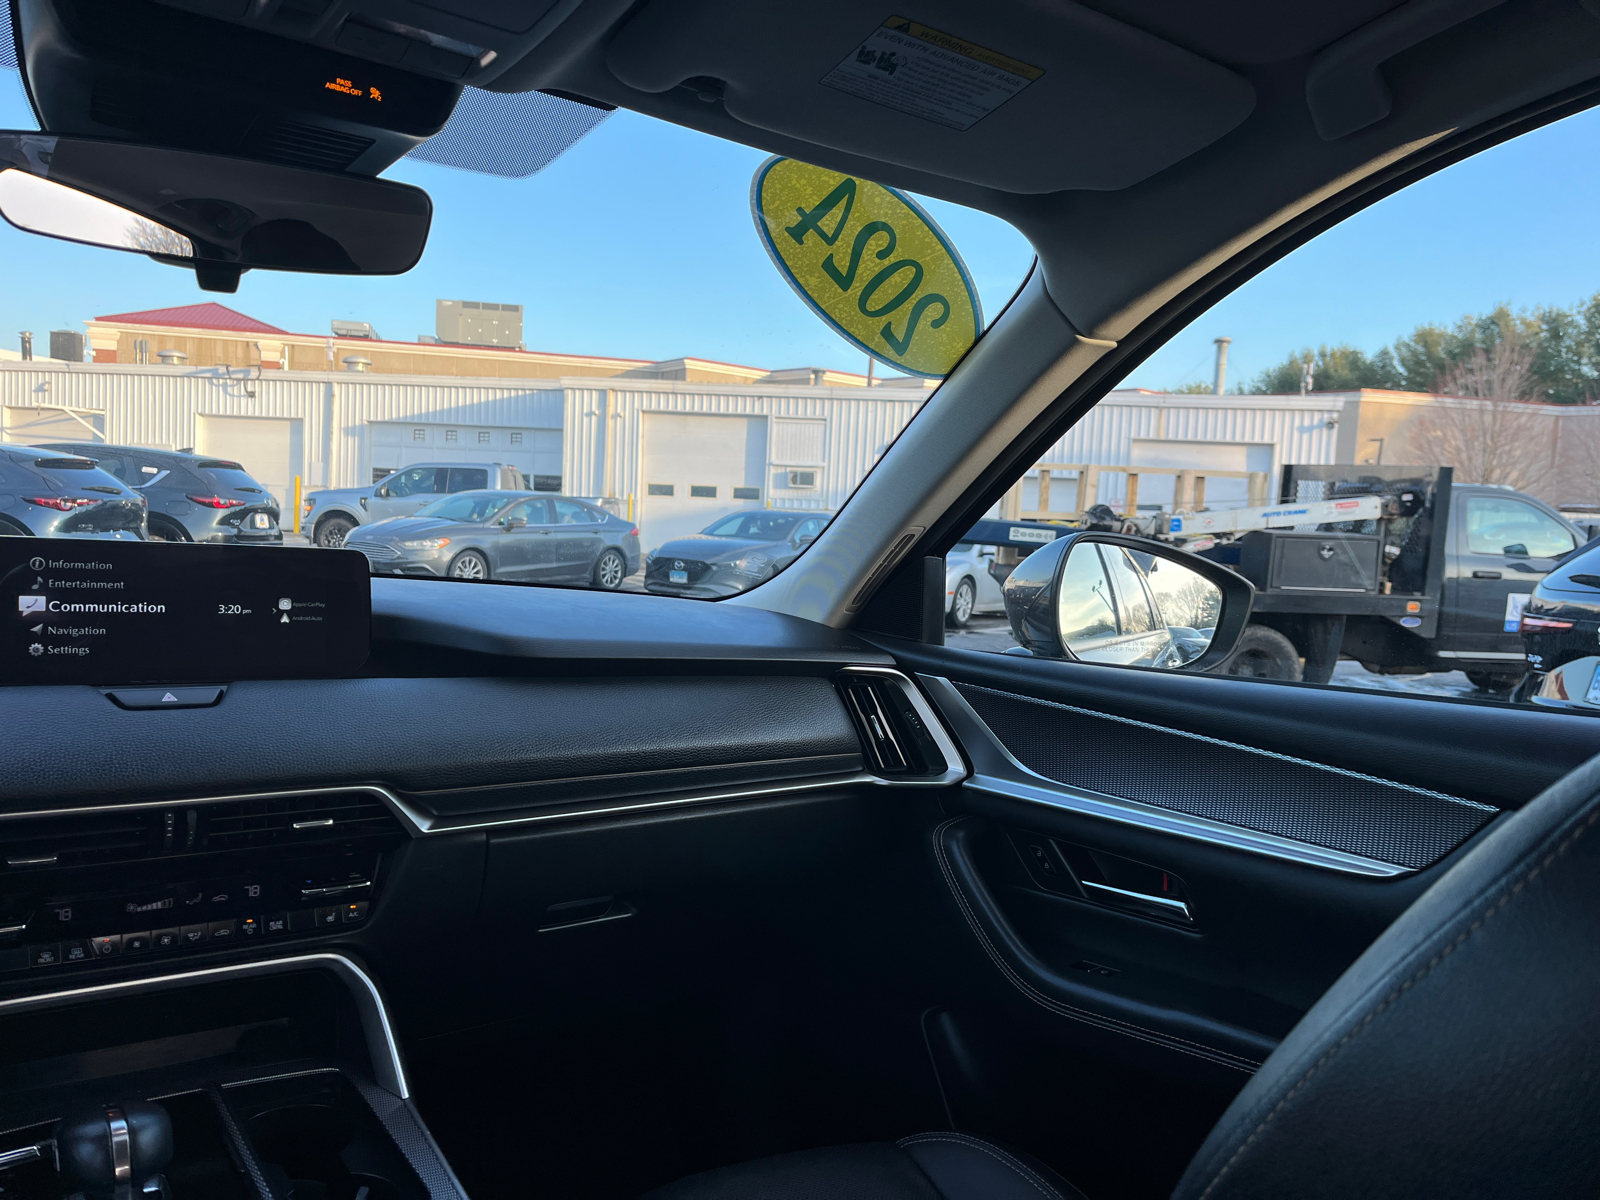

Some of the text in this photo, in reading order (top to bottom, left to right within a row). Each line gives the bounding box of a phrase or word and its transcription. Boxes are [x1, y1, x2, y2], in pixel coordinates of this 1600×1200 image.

[919, 30, 1031, 75] WARNING AVERTISSEMENT
[876, 31, 1023, 87] EVEN WITH ADVANCED AIR BAGS
[336, 78, 352, 87] PASS
[325, 82, 362, 96] AIRBAG OFF
[48, 559, 113, 571] Information
[48, 579, 124, 590] Entertainment
[49, 600, 166, 614] Communication
[218, 604, 241, 615] 3:20
[48, 625, 106, 637] Navigation
[47, 644, 90, 656] Settings
